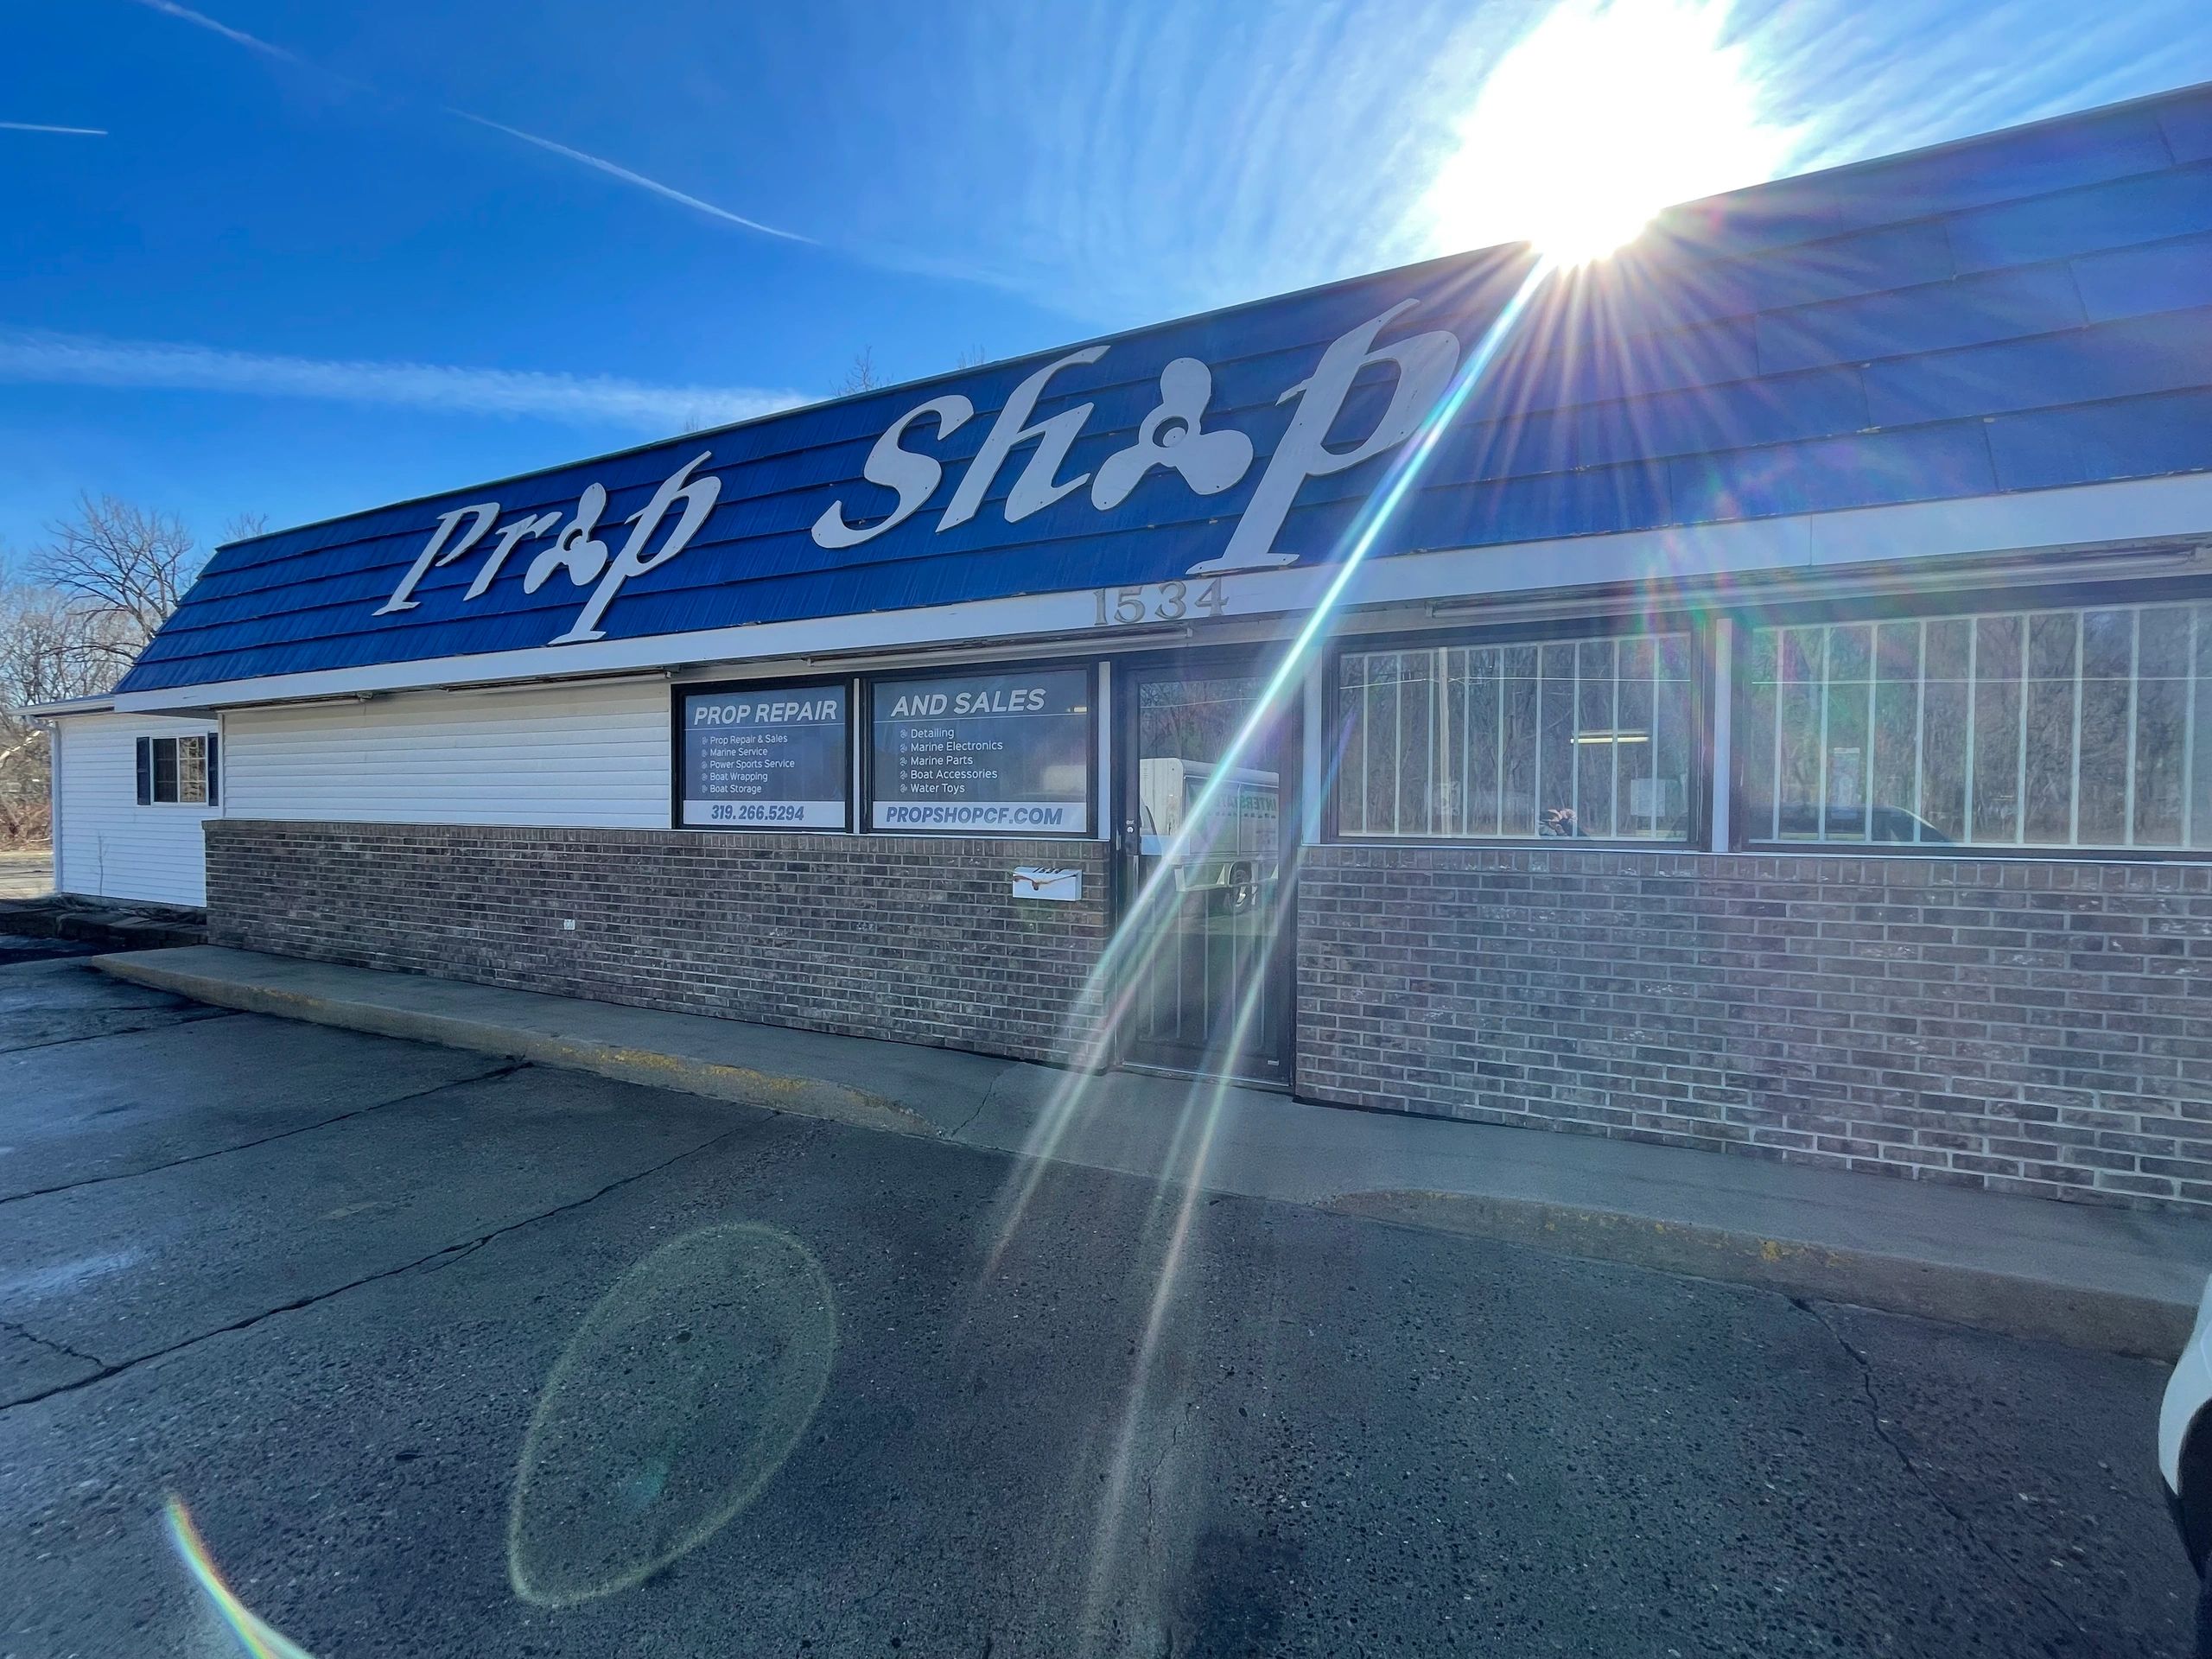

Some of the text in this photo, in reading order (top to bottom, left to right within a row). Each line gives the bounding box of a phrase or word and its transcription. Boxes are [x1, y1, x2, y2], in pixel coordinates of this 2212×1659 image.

[1093, 580, 1230, 626] 1534
[890, 688, 1046, 717] AND SALES
[694, 700, 837, 725] PROP REPAIR
[709, 736, 728, 745] Prop
[730, 735, 756, 746] Repair
[765, 734, 788, 743] Sales
[911, 728, 955, 740] Detailing
[738, 747, 768, 756] Service
[911, 741, 1003, 752] Marine Electronics
[709, 759, 795, 771] Power Sports Service
[911, 755, 973, 766] Marine Parts
[709, 772, 768, 782] Boat Wrapping
[911, 769, 998, 779] Boat Accessories
[709, 784, 762, 795] Boat Storage
[911, 784, 965, 795] Water Toys
[711, 804, 804, 821] 319.266.5294
[886, 806, 1063, 825] PROPSHOPCF.COM
